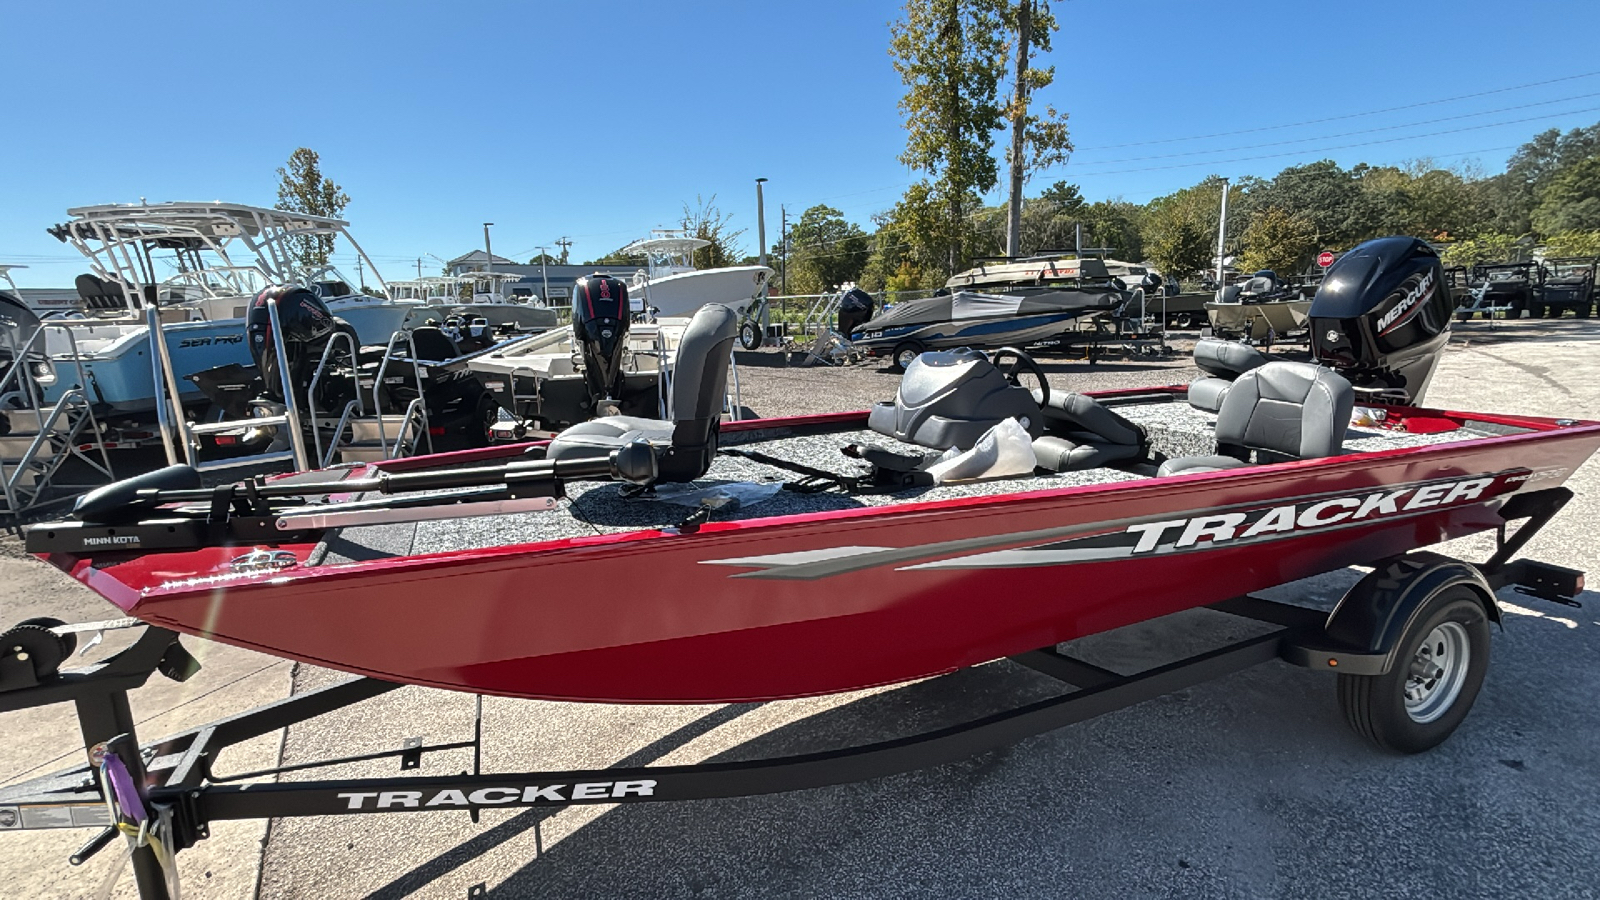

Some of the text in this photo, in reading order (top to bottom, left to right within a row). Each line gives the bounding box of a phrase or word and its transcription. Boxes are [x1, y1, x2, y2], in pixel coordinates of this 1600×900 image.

[1377, 267, 1434, 332] MERCURY
[179, 333, 243, 348] SEA PRO
[1126, 477, 1495, 554] TRACKER
[84, 535, 140, 546] MINN KOTA
[337, 779, 657, 809] TRACKER
